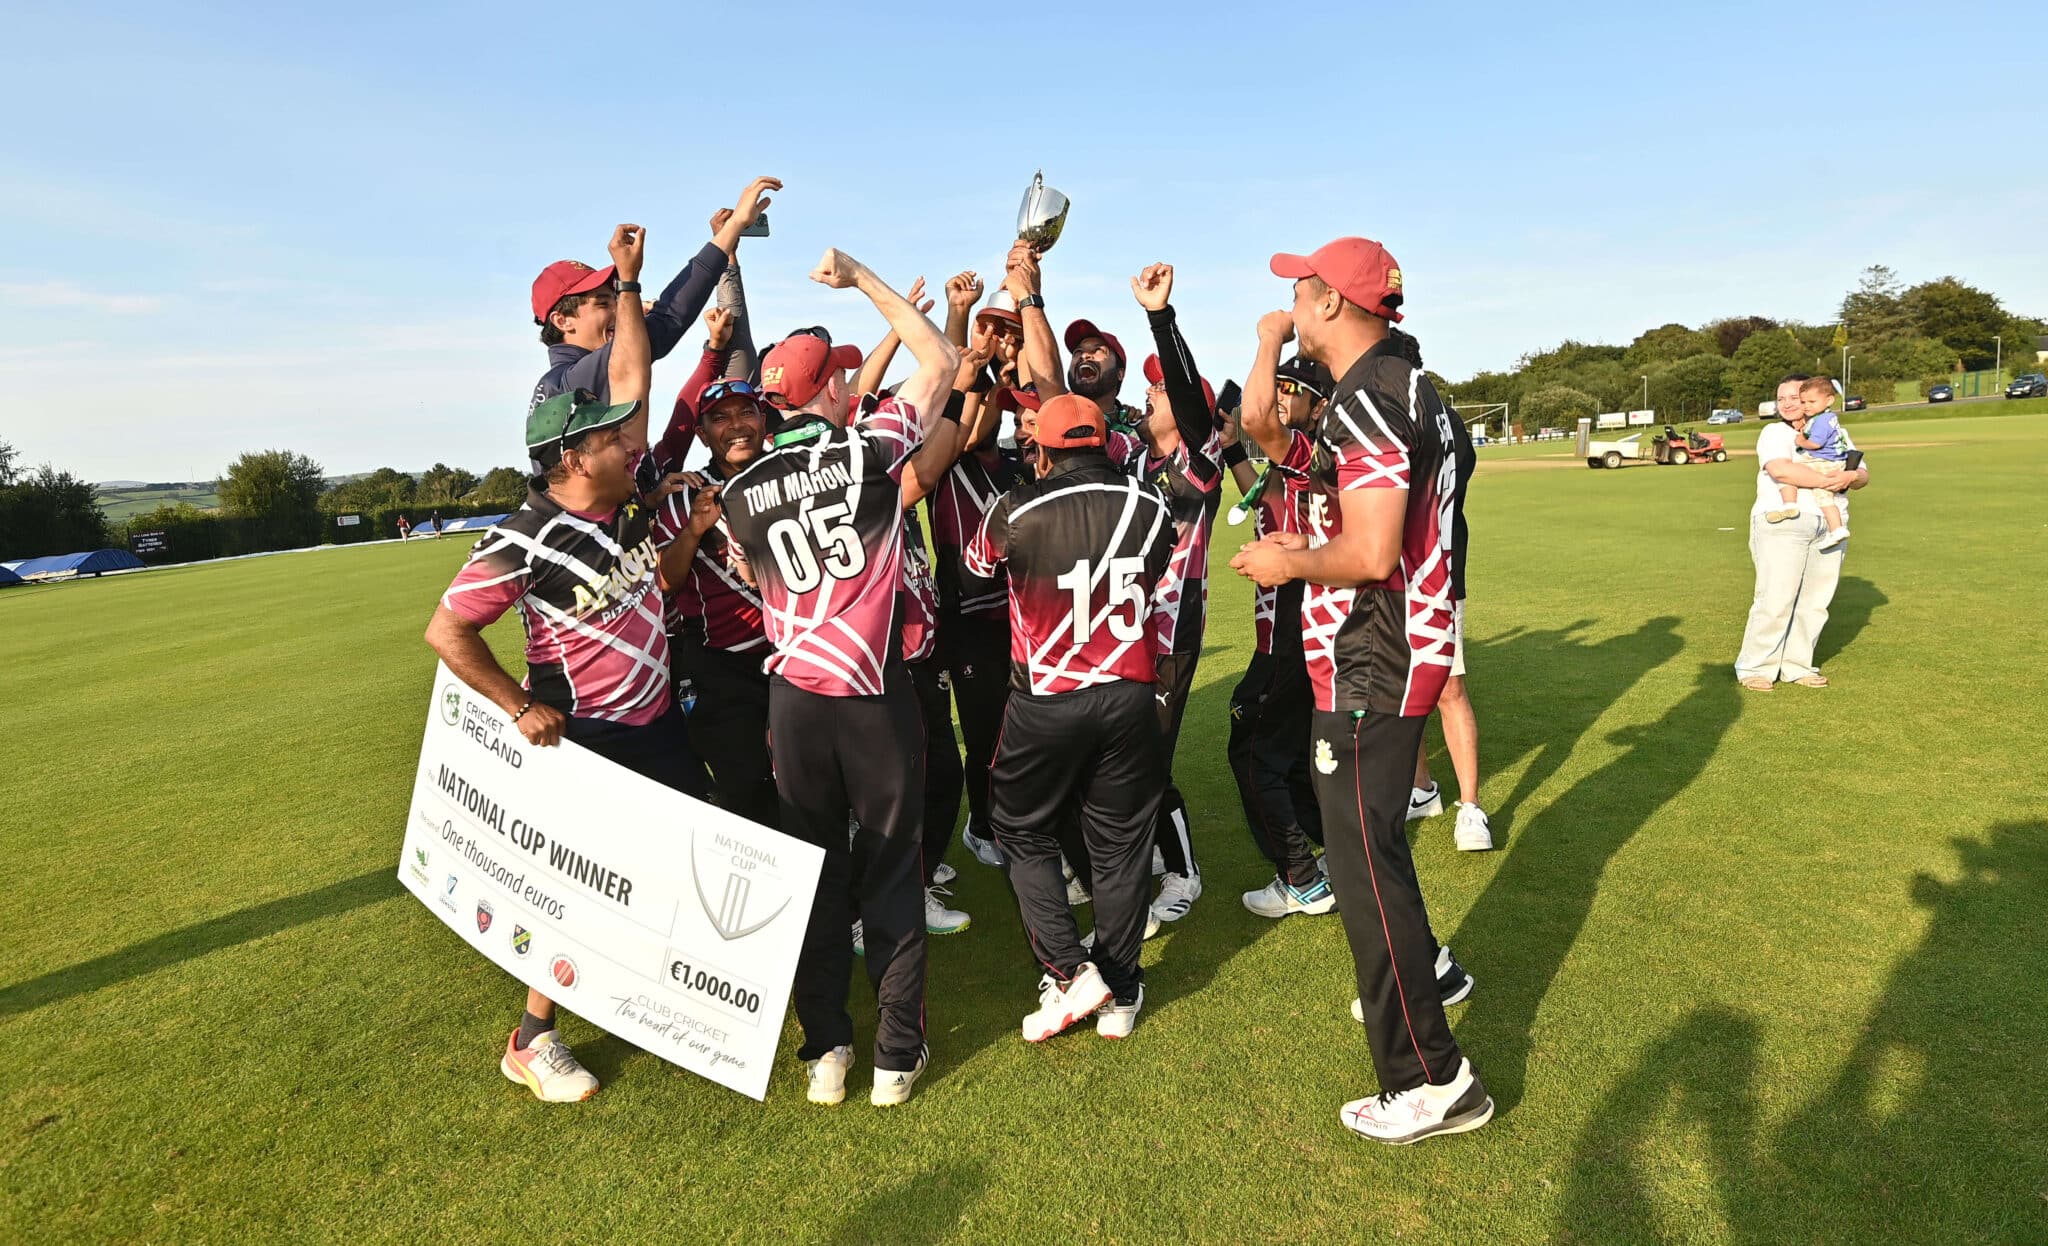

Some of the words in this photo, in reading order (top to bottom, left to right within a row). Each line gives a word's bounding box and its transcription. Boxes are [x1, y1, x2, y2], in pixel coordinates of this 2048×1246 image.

[743, 479, 782, 516] TOM
[783, 461, 854, 502] MAHON
[767, 501, 867, 594] 05
[1057, 555, 1146, 644] 15
[462, 715, 523, 769] IRELAND
[466, 701, 504, 734] CRICKET
[438, 763, 506, 836] NATIONAL
[510, 819, 546, 856] CUP
[549, 840, 633, 906] WINNER
[715, 832, 778, 868] NATIONAL
[442, 819, 464, 852] One
[464, 839, 525, 895] thousand
[524, 885, 566, 920] euros
[730, 855, 757, 872] CUP
[670, 960, 760, 1013] €1,000.00
[610, 996, 638, 1019] The
[638, 1012, 681, 1038] heart
[672, 1029, 690, 1045] of
[688, 1039, 711, 1054] our
[710, 1049, 746, 1069] game
[637, 994, 671, 1018] CLUB
[673, 1011, 730, 1044] CRICKET
